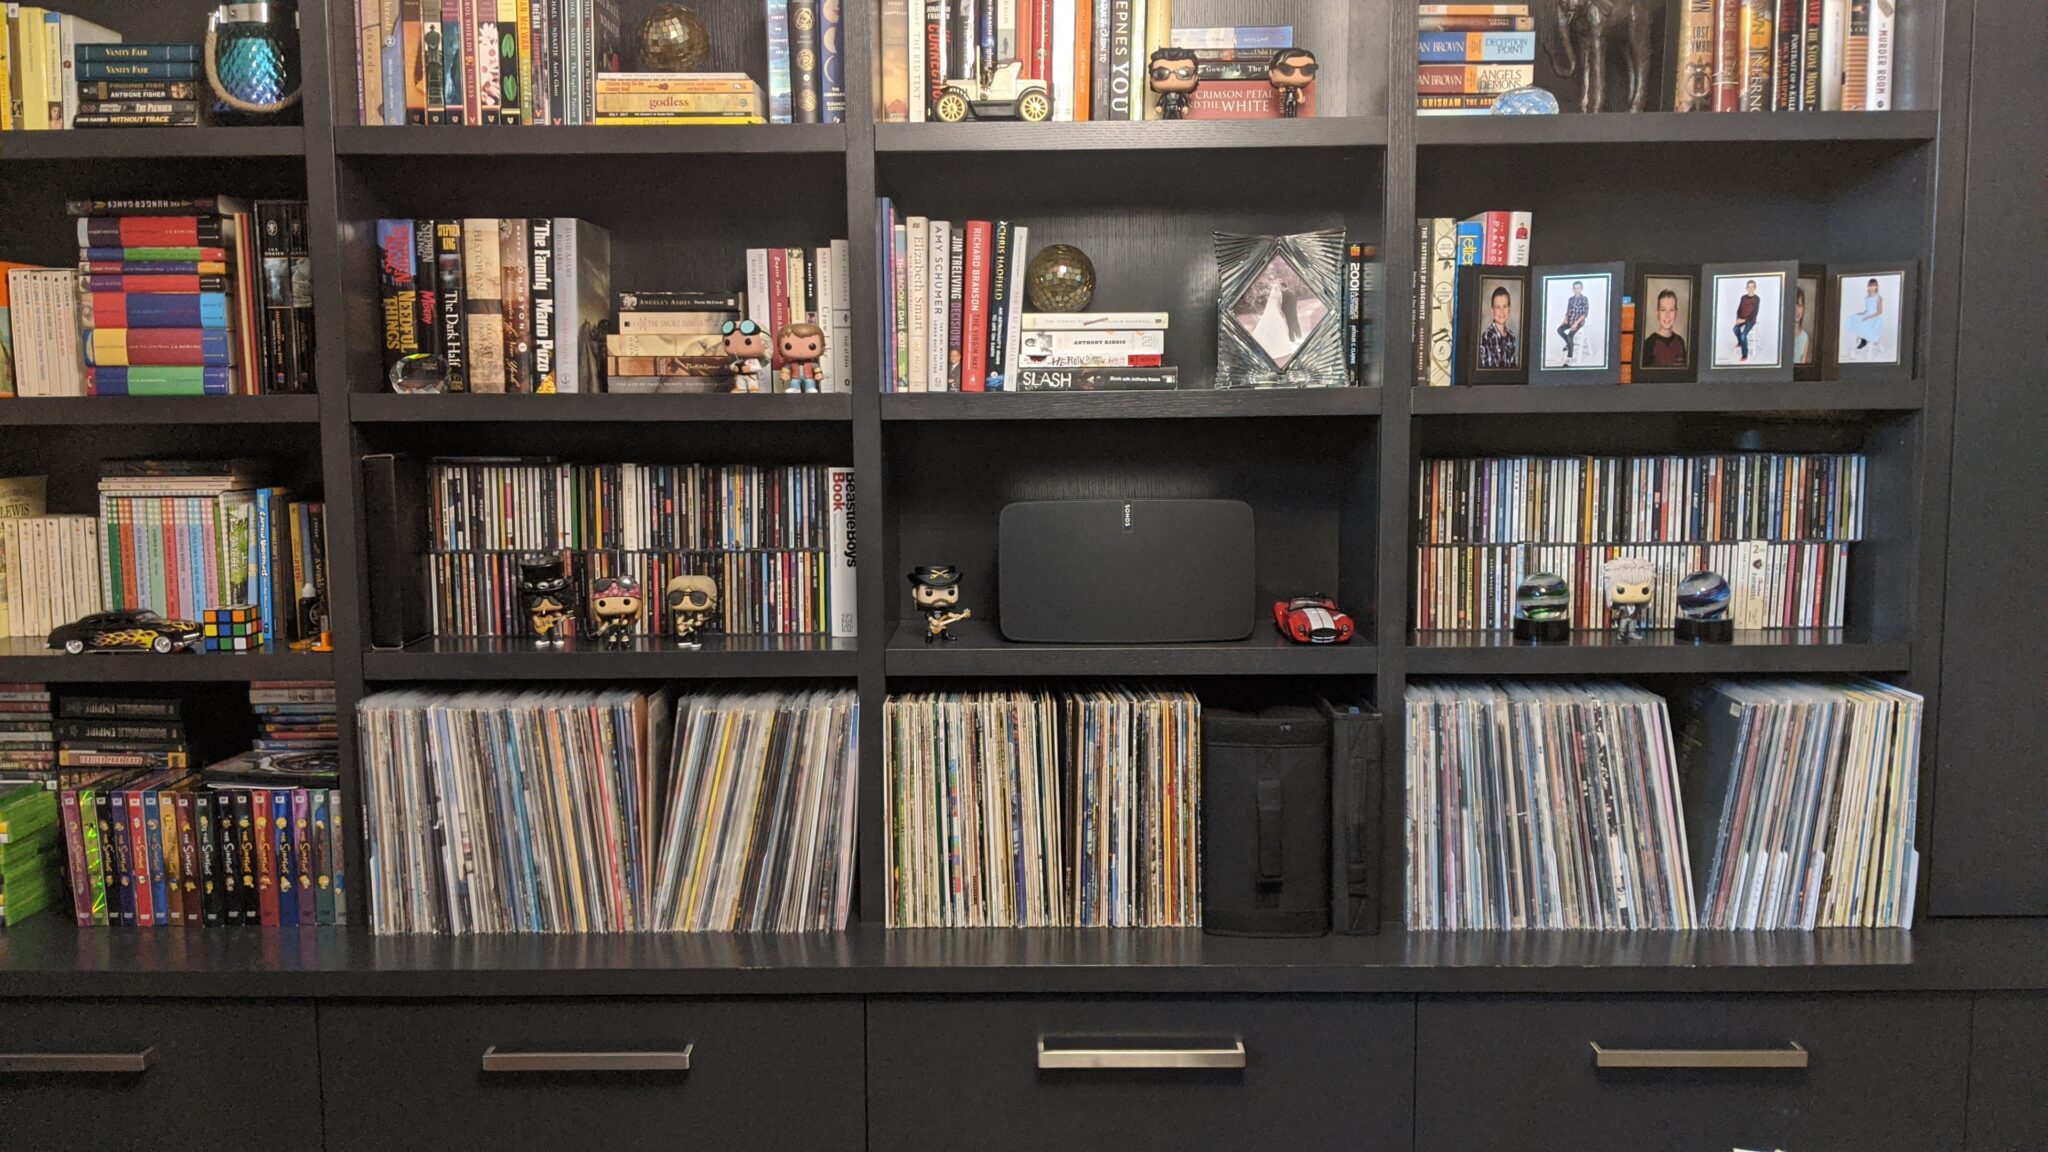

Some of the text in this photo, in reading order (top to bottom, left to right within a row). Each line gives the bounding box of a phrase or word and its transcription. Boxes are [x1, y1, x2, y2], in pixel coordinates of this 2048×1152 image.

[1433, 42, 1464, 52] BROWN
[1692, 26, 1709, 38] LOST
[105, 48, 148, 56] VANITY FAIR
[1112, 1, 1129, 114] EPNES YOU
[1790, 34, 1799, 71] PORTRAIT
[1806, 28, 1818, 104] THE STONE MONKEY
[1876, 30, 1888, 94] MURDER ROOM
[106, 64, 149, 74] VANITY FAIR
[1431, 75, 1462, 85] BROWN
[1480, 70, 1522, 79] ANGELS
[1790, 73, 1796, 83] OF
[1196, 90, 1274, 100] CRIMSON PETAL
[1480, 80, 1521, 89] DEMONS
[649, 96, 689, 109] godless
[1201, 100, 1269, 112] THE WHITE
[1422, 98, 1461, 106] GRISHAM
[416, 224, 434, 262] STEPHEN KING
[438, 224, 460, 238] STEPHEN
[442, 238, 456, 250] KING
[473, 230, 484, 291] HISTORIAN
[972, 228, 982, 267] RICHARD
[934, 226, 943, 315] AMY SCHUMER
[994, 226, 1007, 301] CHRIS HADFIELD
[1350, 262, 1360, 291] 2001
[517, 257, 526, 330] JOHNSTON
[914, 236, 925, 330] Elizabeth Smart
[950, 236, 963, 346] JIM TRELIVING DECISIONS
[971, 270, 981, 312] BRANSON
[1420, 276, 1426, 284] OF
[420, 290, 436, 324] MISERY
[533, 224, 553, 372] The Family Mario Puzo
[384, 296, 399, 350] THINGS
[398, 290, 418, 354] NEEDFUL
[444, 290, 460, 368] The Dark Half
[972, 314, 980, 328] THE
[506, 359, 519, 388] York
[1022, 372, 1072, 387] SLASH
[832, 472, 846, 512] Book
[0, 504, 30, 518] LEWIS
[80, 756, 142, 765] TRAILER PARK BOYS
[182, 845, 194, 876] SIMPSONS
[202, 844, 214, 875] SIMPSONS
[224, 843, 234, 874] SIMPSONS
[242, 842, 252, 872] SIMPSONS
[280, 843, 290, 874] SIMPSONS
[300, 842, 310, 872] SIMPSONS
